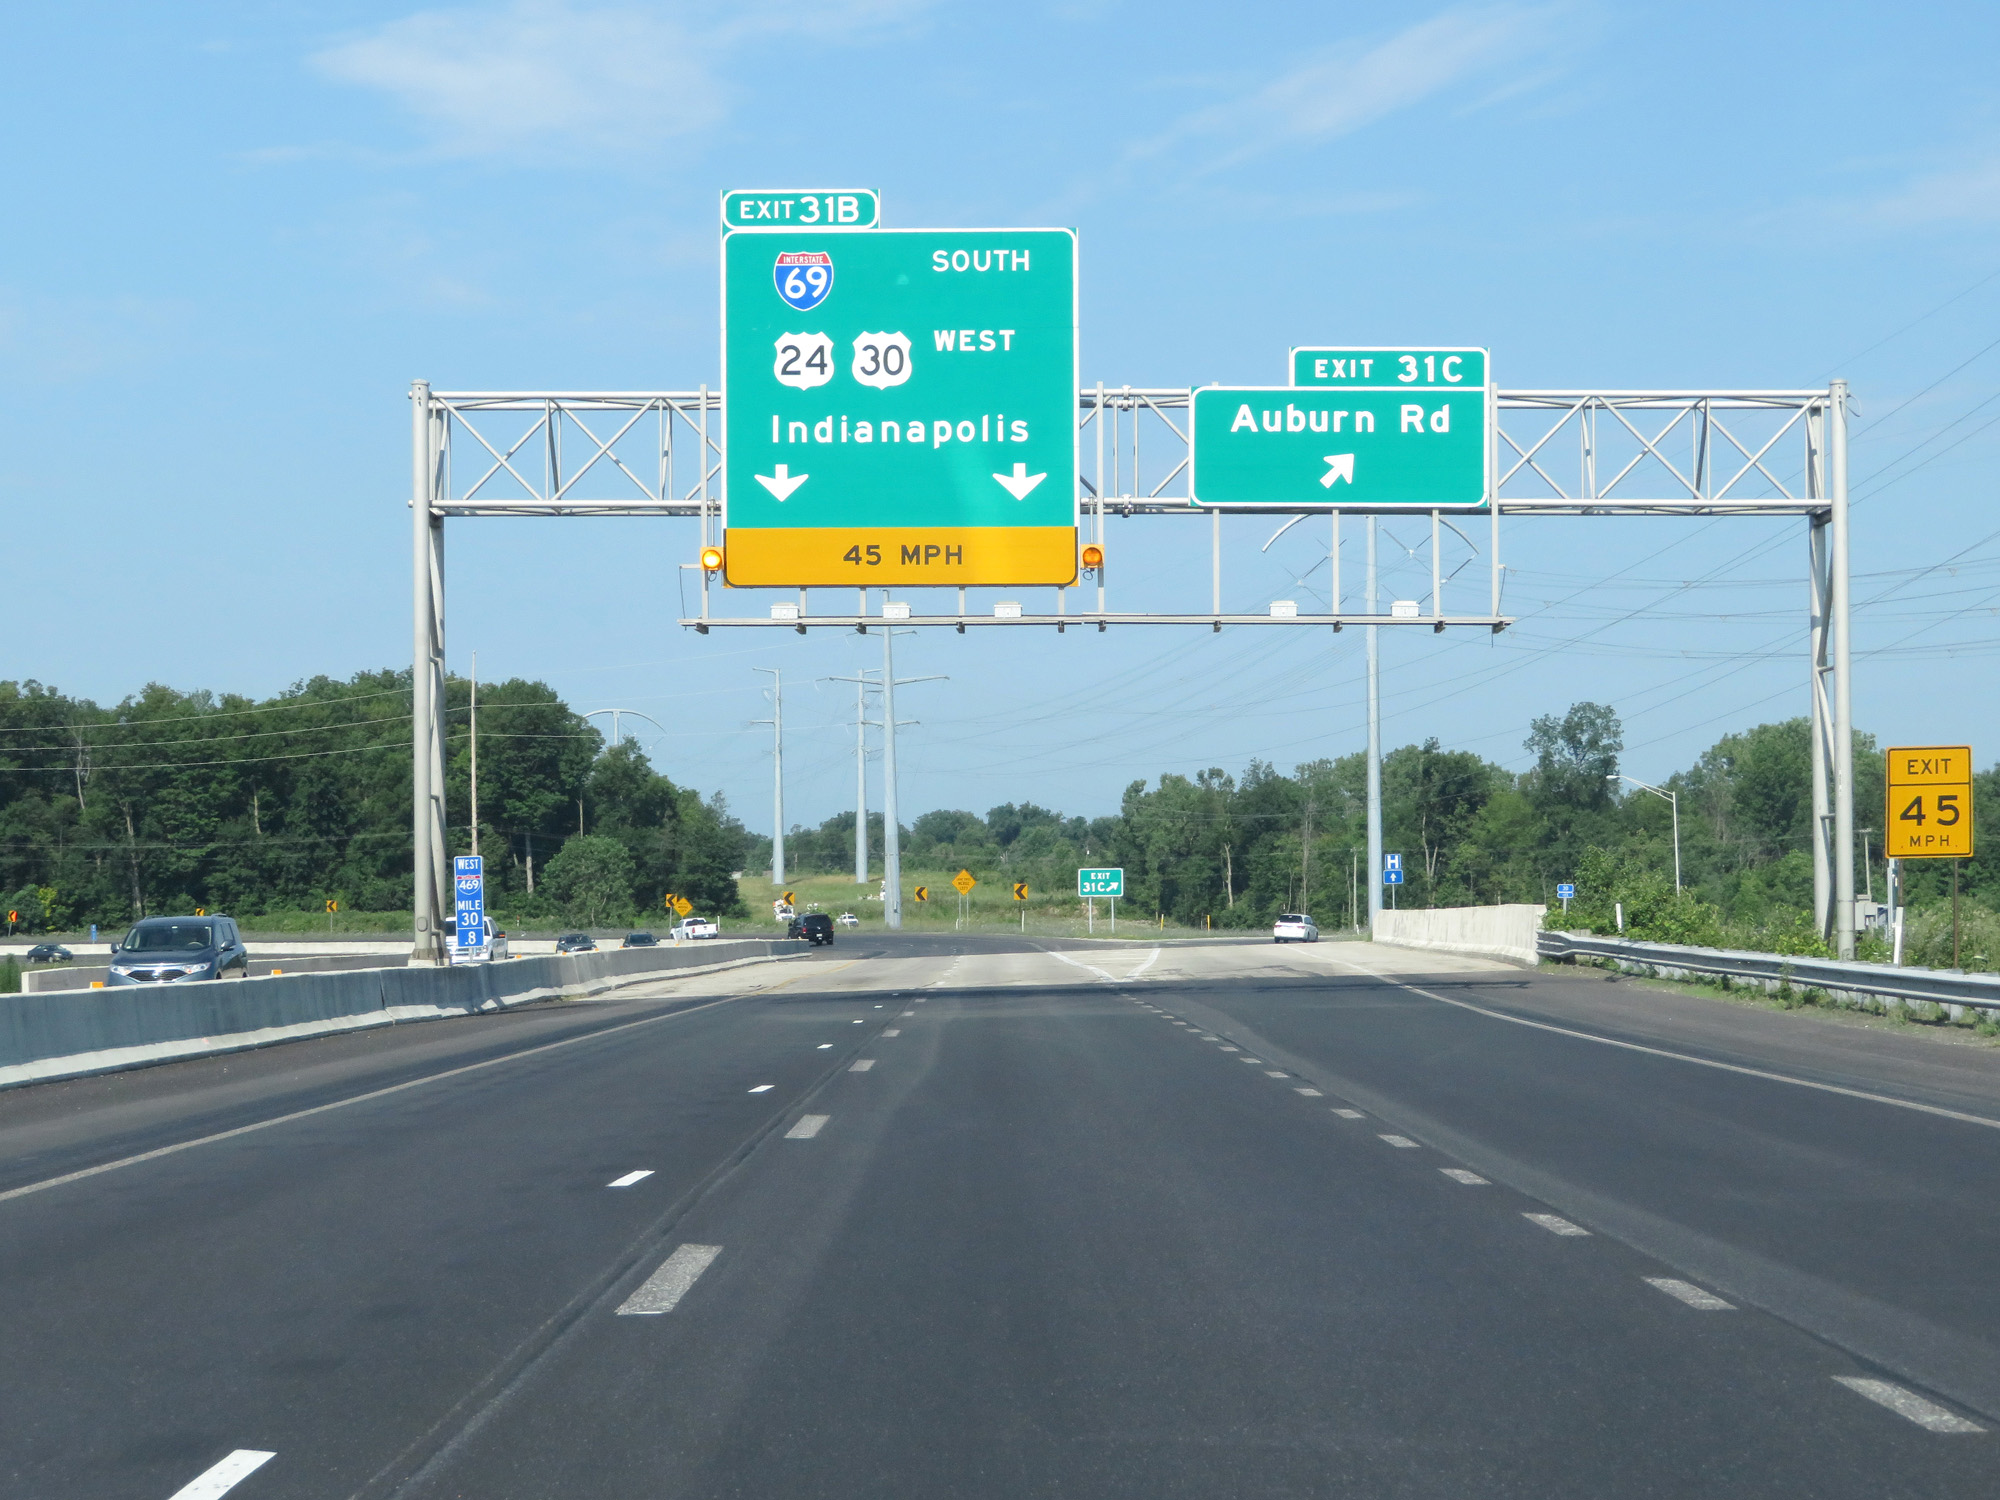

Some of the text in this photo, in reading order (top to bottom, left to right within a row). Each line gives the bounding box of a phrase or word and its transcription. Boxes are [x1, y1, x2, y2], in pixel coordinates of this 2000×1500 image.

[740, 196, 859, 223] EXIT 31B
[783, 256, 824, 264] INTERSTATE
[932, 249, 1030, 272] SOUTH
[784, 266, 828, 299] 69
[933, 329, 1015, 352] WEST
[781, 344, 905, 377] 24 30
[1315, 355, 1463, 383] EXIT 31C
[1230, 403, 1450, 433] Auburn Rd
[772, 413, 1029, 449] Indianapolis
[843, 544, 963, 566] 45 MPH
[1907, 758, 1951, 775] EXIT
[1899, 795, 1960, 826] 45
[1909, 835, 1950, 847] MPH
[457, 859, 479, 869] WEST
[1387, 855, 1399, 869] H
[459, 879, 479, 890] 469
[1083, 882, 1105, 892] 31C
[457, 900, 481, 911] MILE
[461, 912, 479, 926] 30
[465, 931, 476, 945] .8
